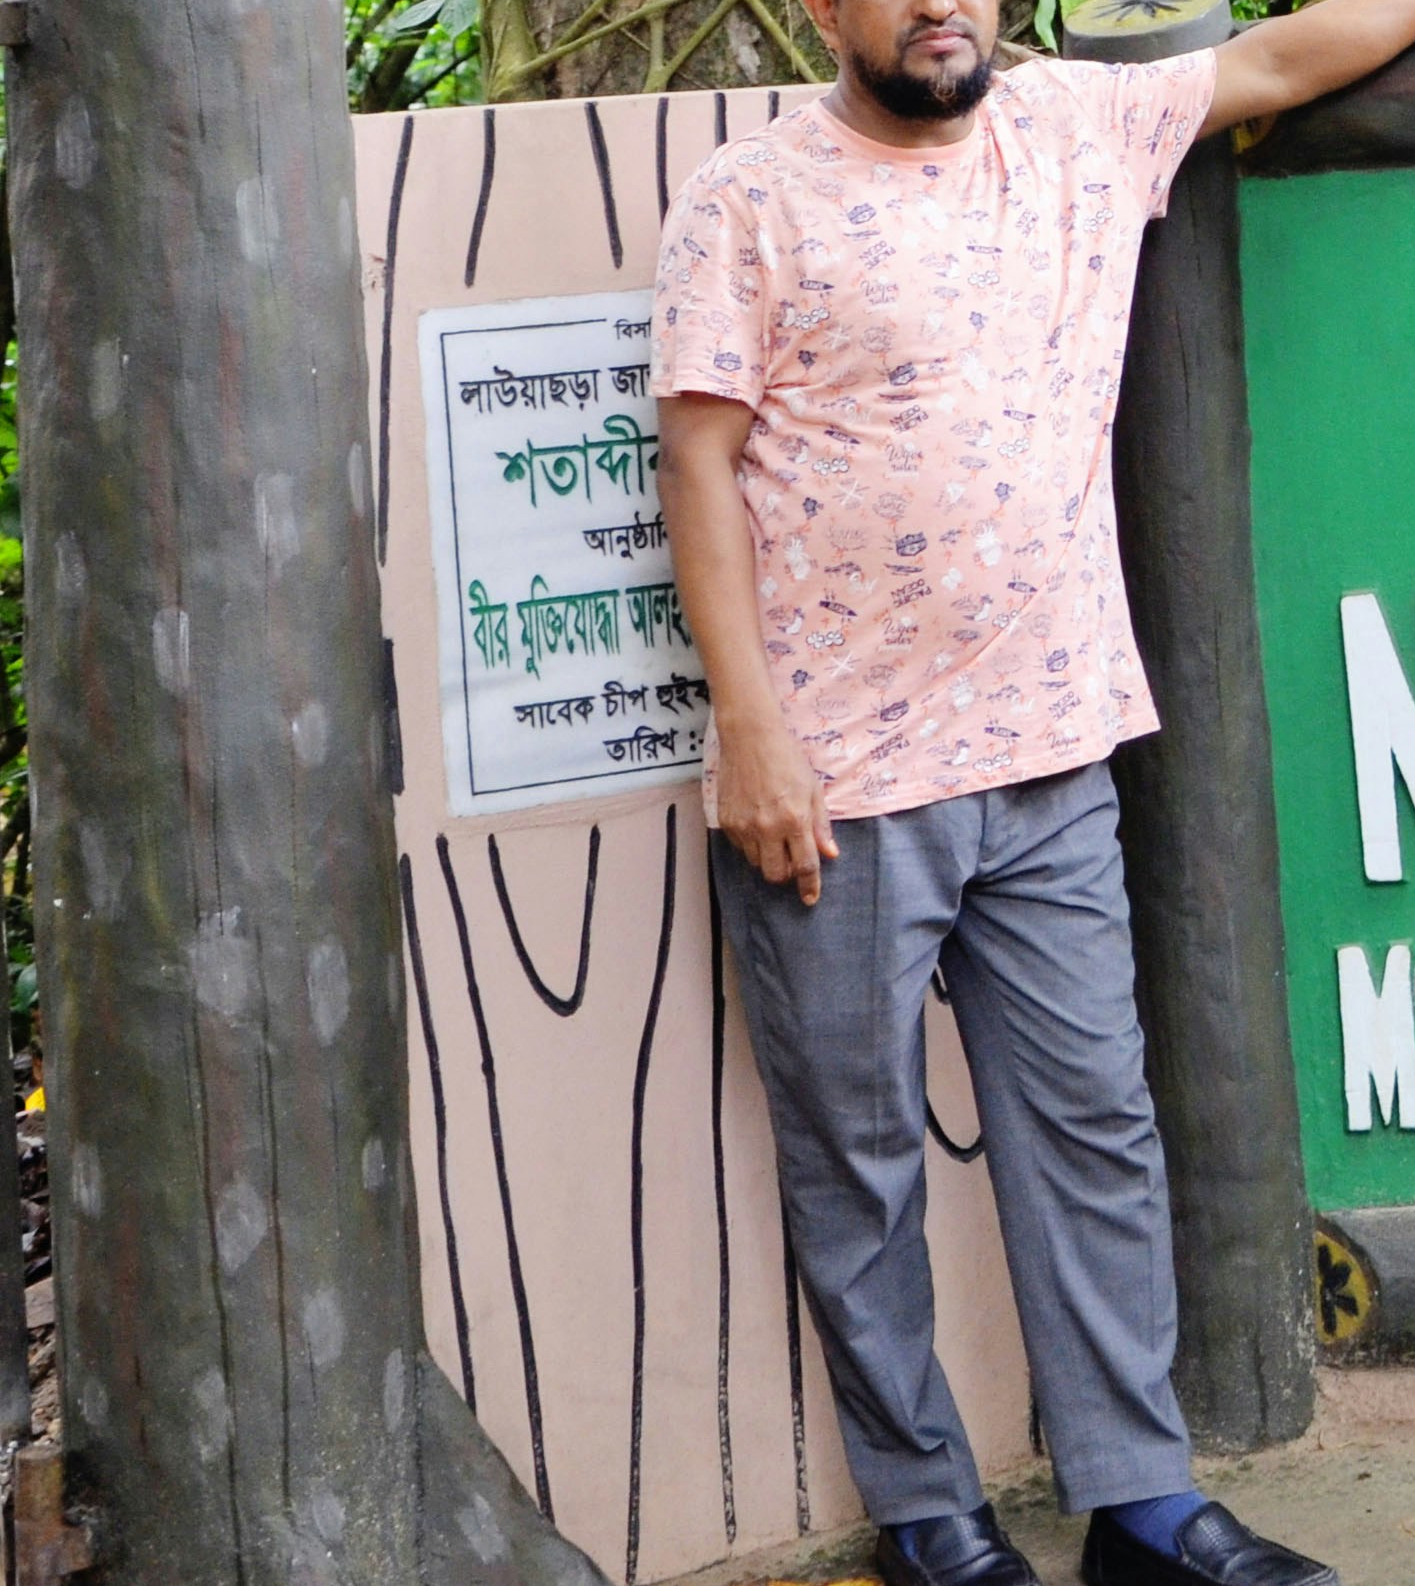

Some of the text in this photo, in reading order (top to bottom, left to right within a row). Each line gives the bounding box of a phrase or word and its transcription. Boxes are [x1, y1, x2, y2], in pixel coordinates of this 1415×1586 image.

[459, 365, 602, 414] লাউয়াছড়া
[469, 574, 621, 680] বীর মুক্তিযোদ্ধা
[513, 696, 596, 729] সাবেক
[601, 680, 649, 718] চীপ
[603, 726, 678, 763] তারিখ
